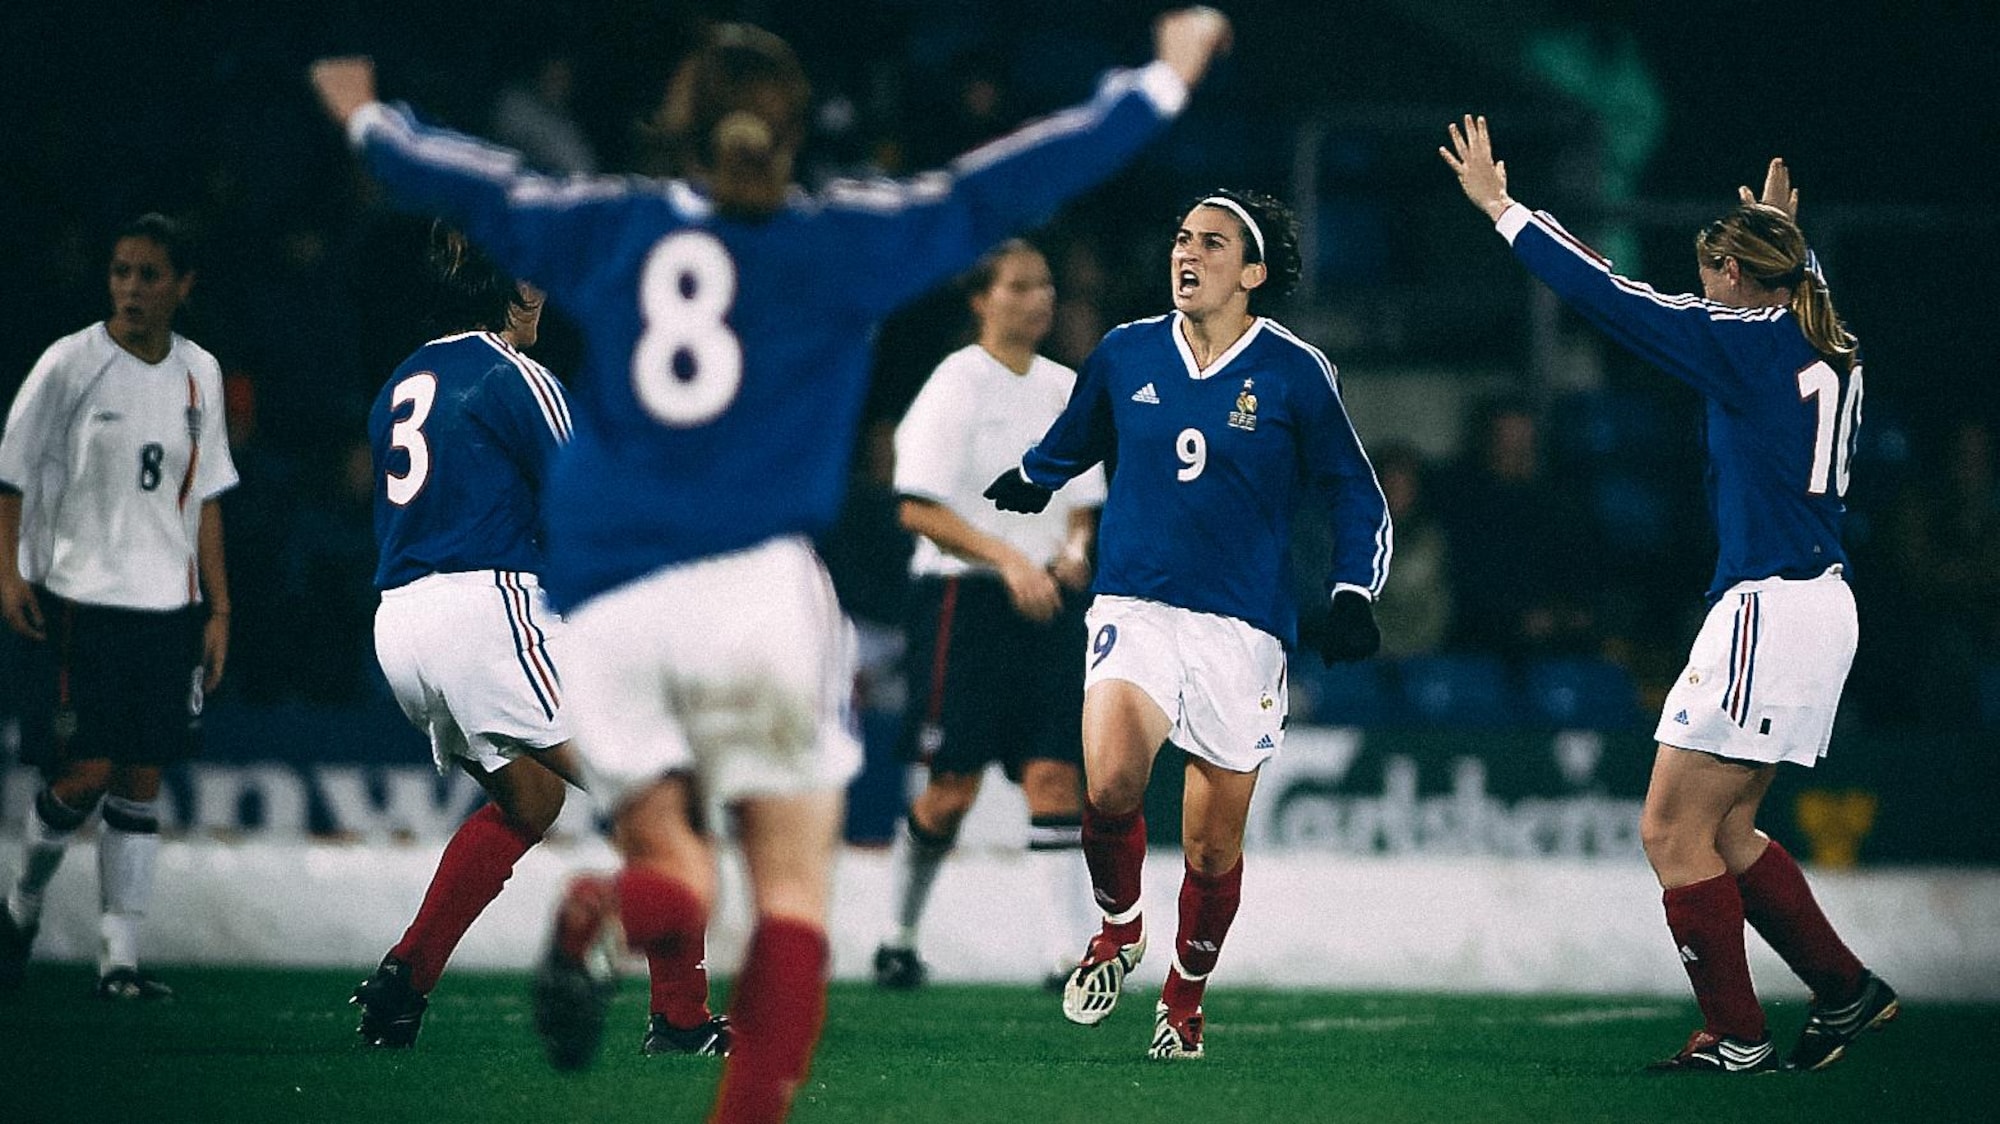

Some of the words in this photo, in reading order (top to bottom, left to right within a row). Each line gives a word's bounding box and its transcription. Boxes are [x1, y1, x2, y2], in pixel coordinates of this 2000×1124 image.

[631, 228, 744, 427] 8
[140, 441, 164, 492] 8
[386, 370, 438, 507] 3
[1176, 427, 1206, 481] 9
[1797, 359, 1864, 497] 10
[1091, 623, 1117, 670] 9
